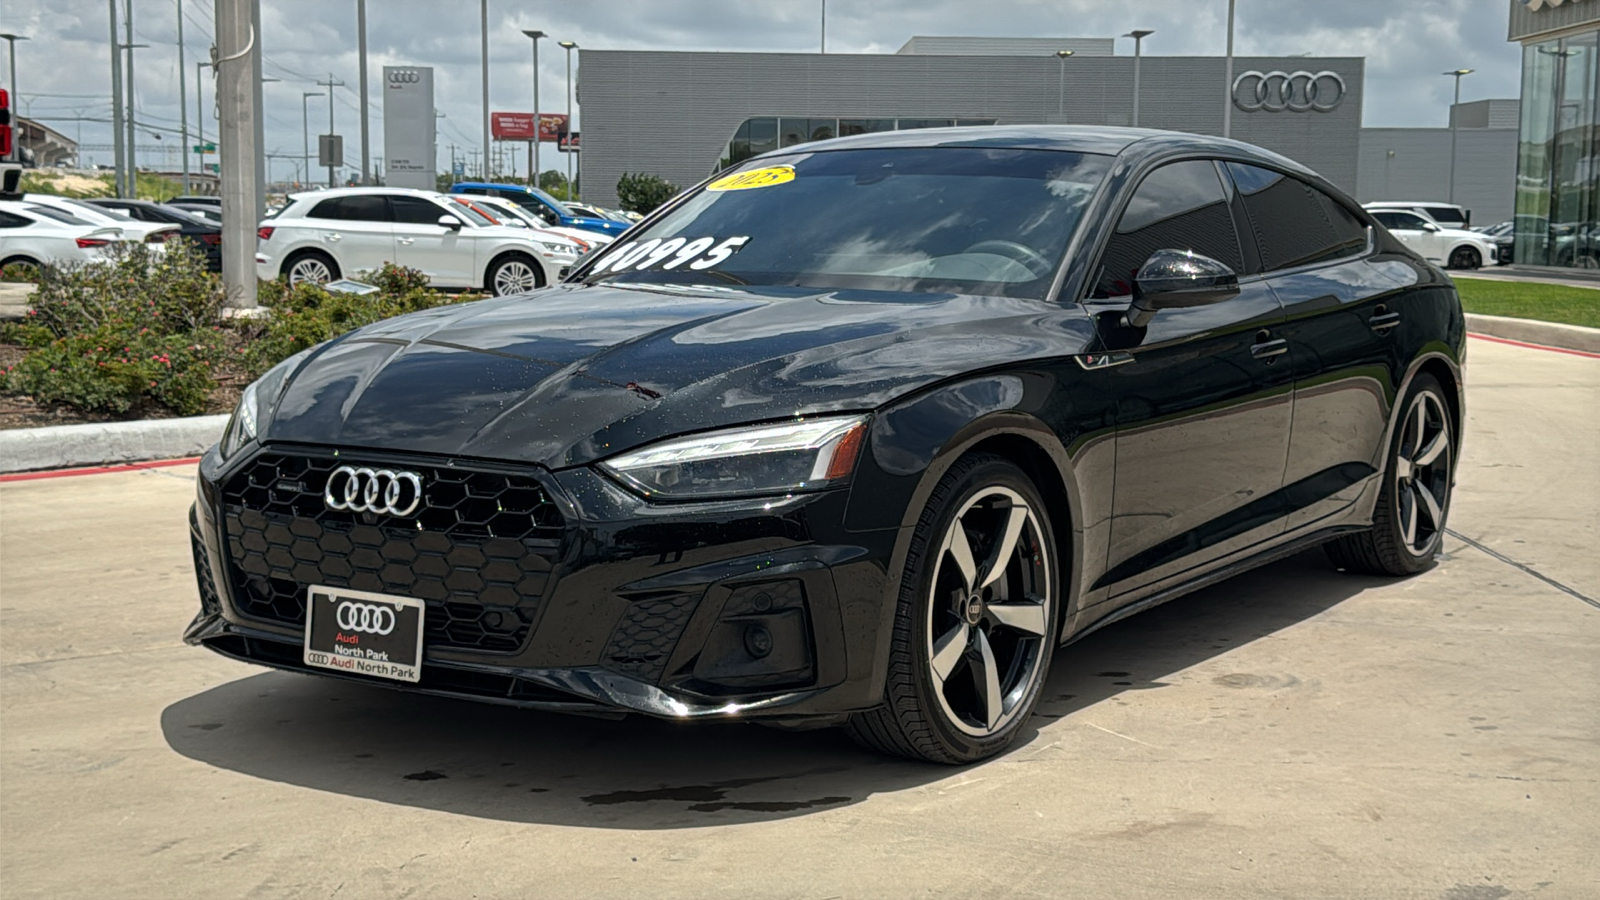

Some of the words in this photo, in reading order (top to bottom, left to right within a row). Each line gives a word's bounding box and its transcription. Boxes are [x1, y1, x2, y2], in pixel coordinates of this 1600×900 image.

[336, 632, 359, 644] Audi
[335, 644, 364, 657] North
[366, 649, 388, 661] Park
[330, 657, 354, 669] Audi
[357, 661, 388, 674] North
[390, 666, 415, 679] Park
